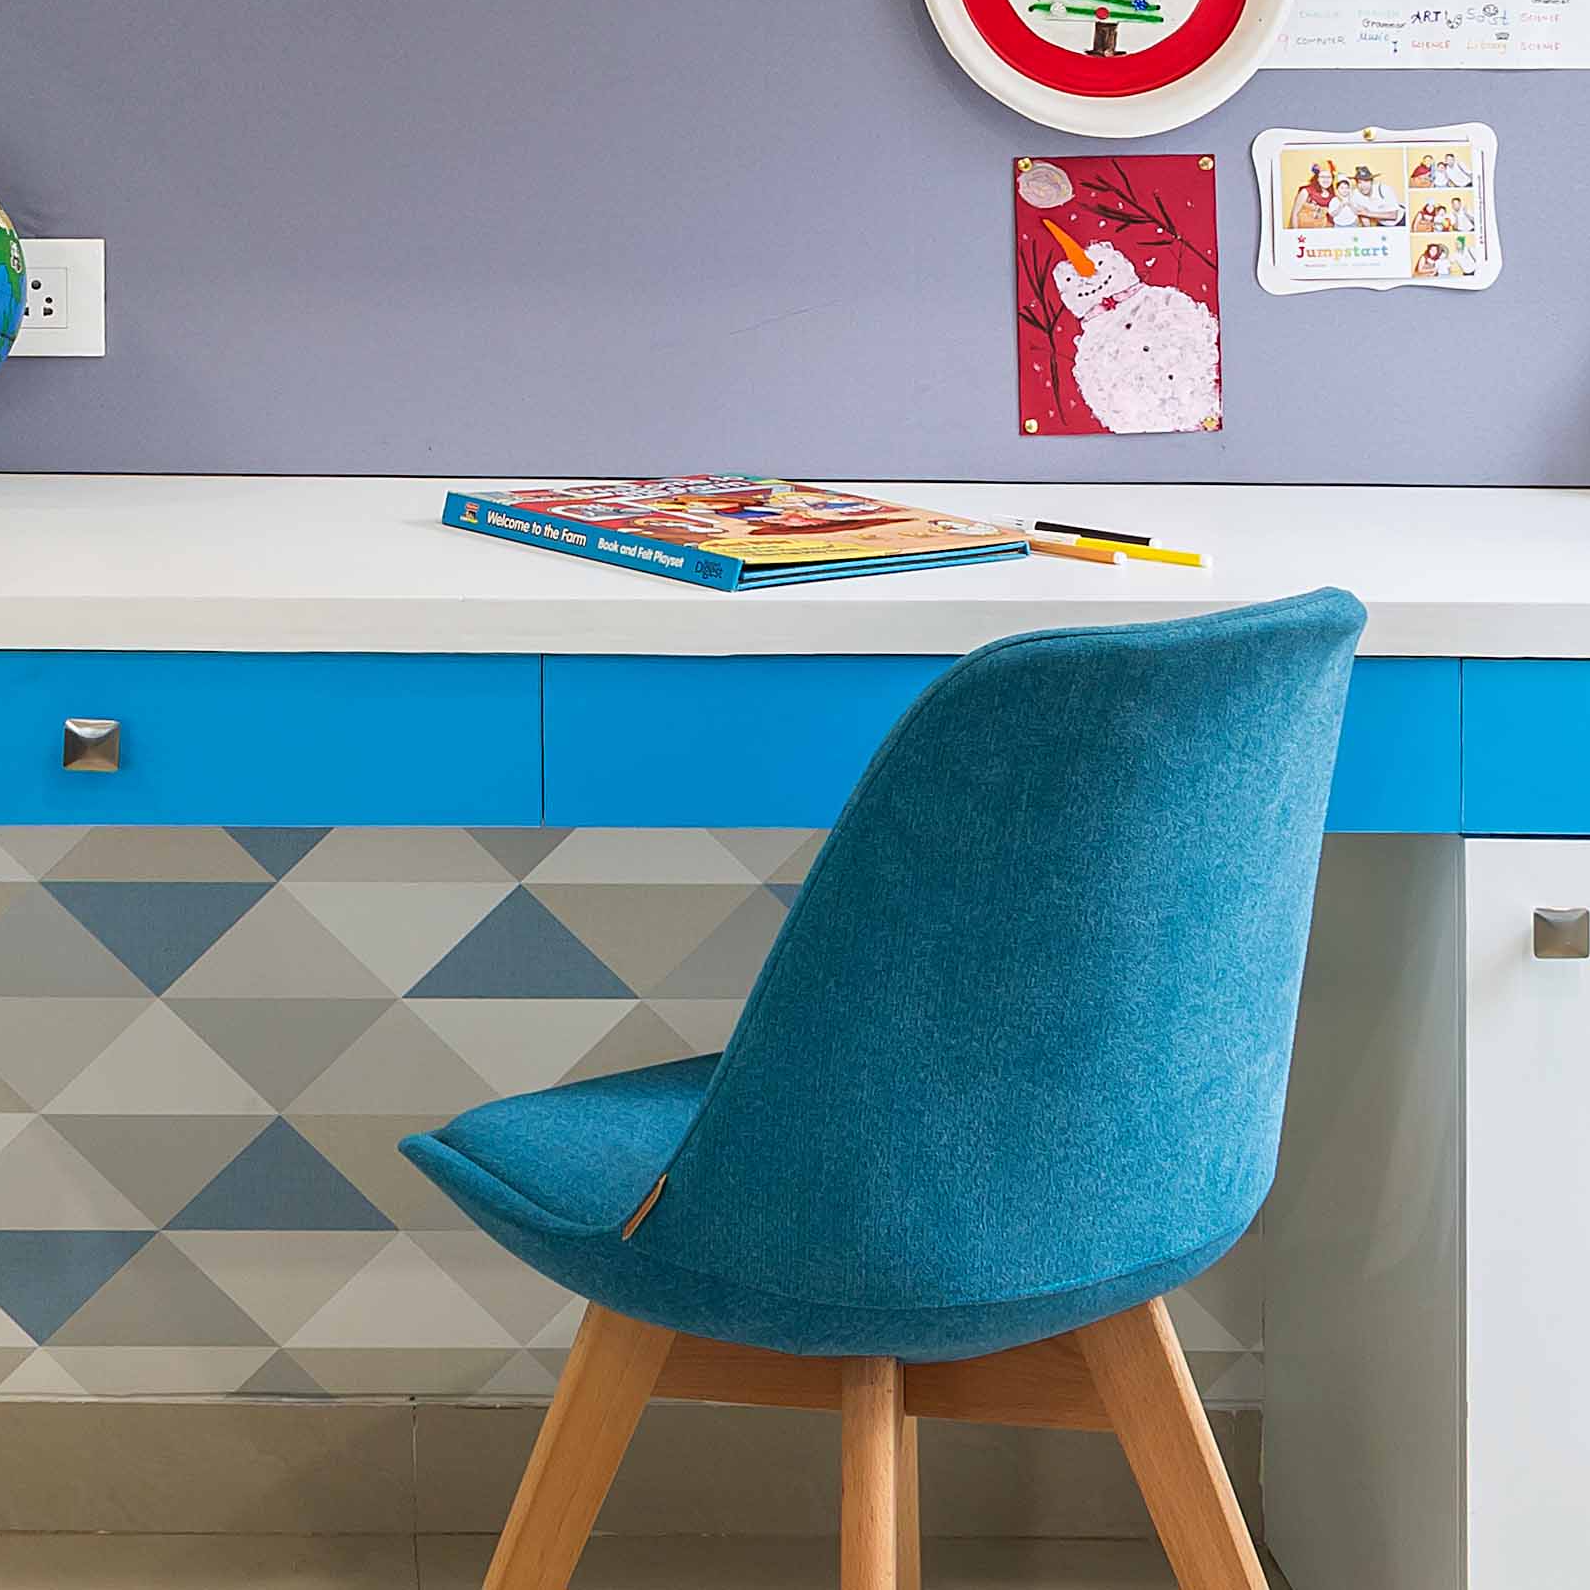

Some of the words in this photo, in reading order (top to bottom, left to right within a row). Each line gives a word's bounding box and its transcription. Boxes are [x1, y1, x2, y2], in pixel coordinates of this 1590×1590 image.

[1411, 11, 1441, 24] ART
[1296, 37, 1346, 45] COMPUTER
[1411, 41, 1451, 49] SCIENCE
[1296, 245, 1389, 260] Jumpstart
[486, 509, 531, 534] Welcome
[531, 522, 541, 536] to
[543, 523, 559, 540] the
[561, 528, 587, 547] Farm
[597, 537, 619, 552] Book
[619, 544, 637, 558] and
[637, 546, 653, 561] Felt
[653, 550, 685, 569] Playset
[695, 560, 723, 579] Digest
